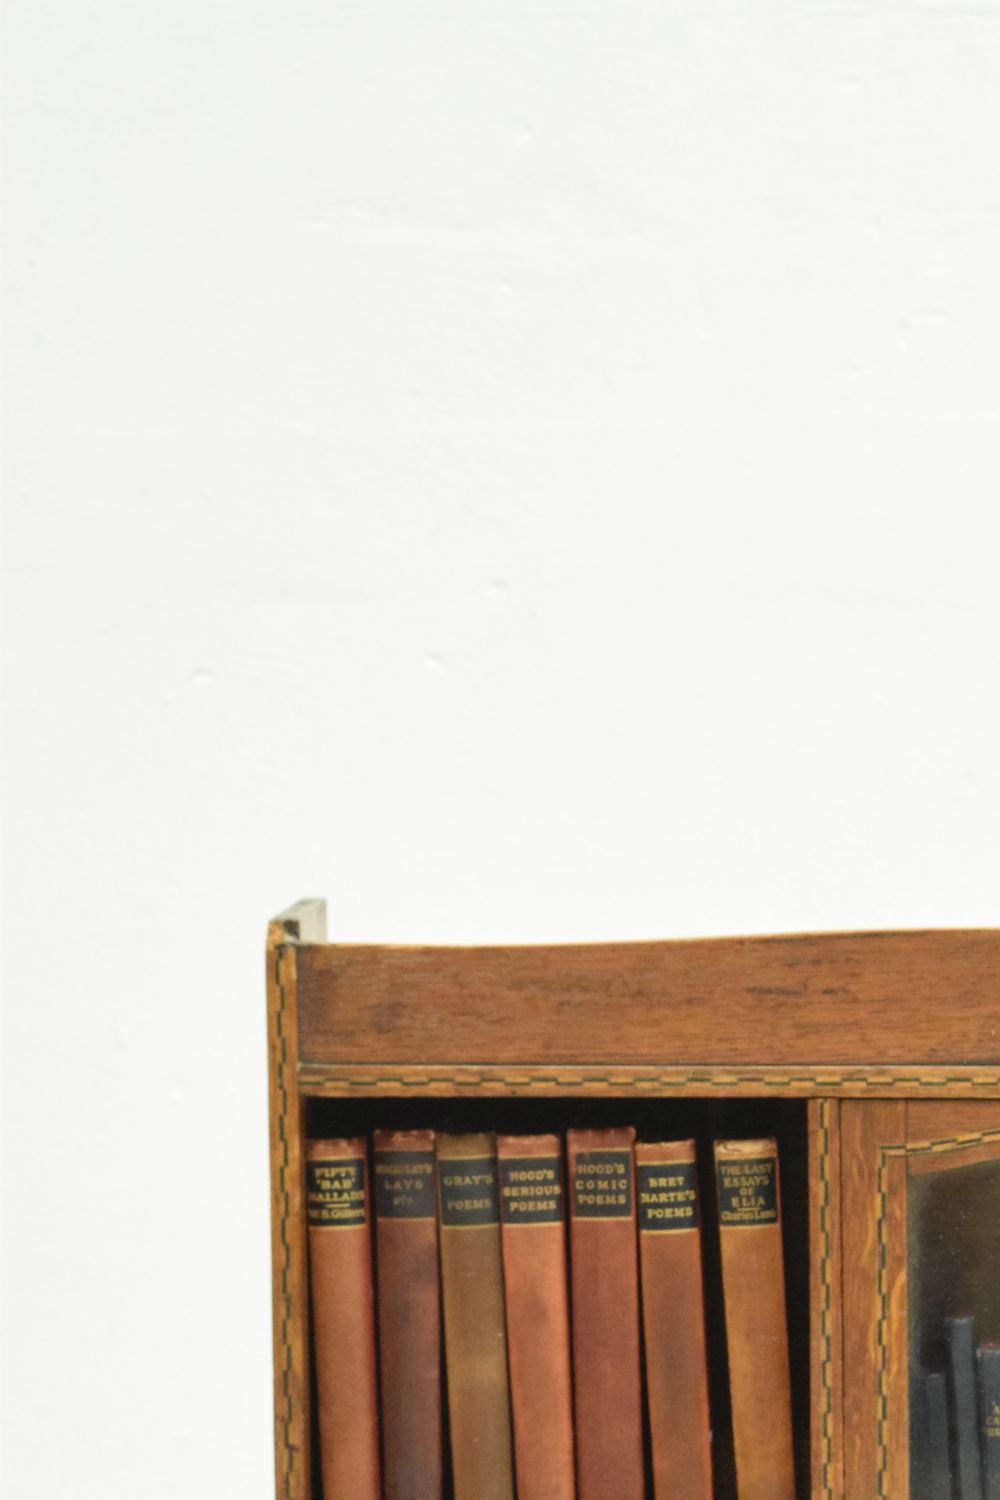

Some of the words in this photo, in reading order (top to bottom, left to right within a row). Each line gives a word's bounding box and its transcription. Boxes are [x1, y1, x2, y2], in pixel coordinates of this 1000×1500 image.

[315, 1166, 357, 1179] FIFTY
[509, 1169, 555, 1181] HOOD'S
[577, 1163, 626, 1175] HOOD'S
[444, 1175, 493, 1187] GRAY'S
[575, 1179, 628, 1190] COMIC
[649, 1176, 685, 1188] BRET
[724, 1176, 770, 1188] ESSAYS
[503, 1185, 561, 1197] SERIOUS
[641, 1190, 696, 1203] HARTE'S
[447, 1198, 492, 1210] POEMS
[577, 1194, 627, 1205] POEMS
[731, 1196, 767, 1208] ELIA
[509, 1201, 557, 1212] POEMS
[647, 1206, 693, 1219] POEMS
